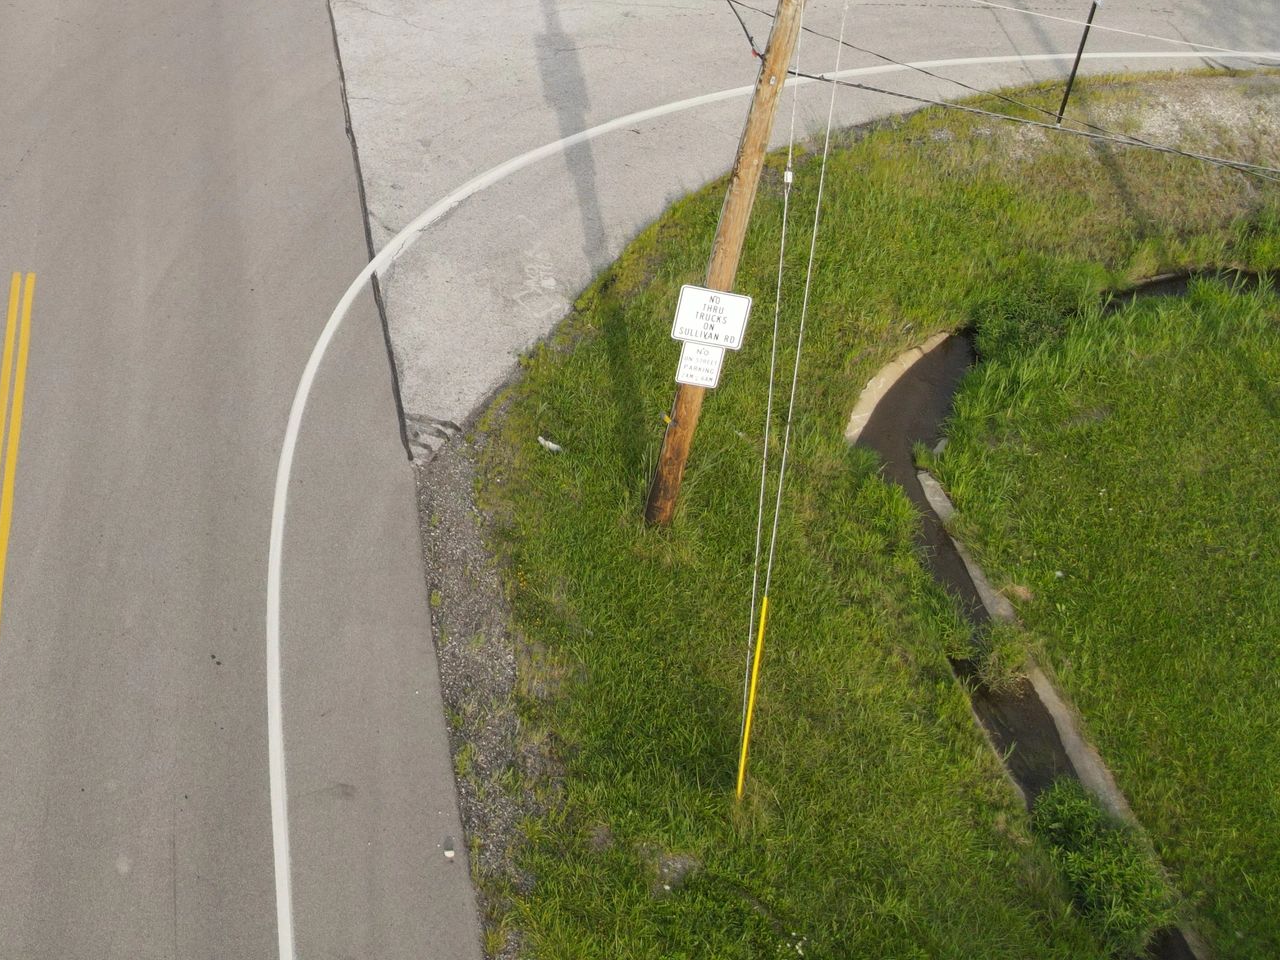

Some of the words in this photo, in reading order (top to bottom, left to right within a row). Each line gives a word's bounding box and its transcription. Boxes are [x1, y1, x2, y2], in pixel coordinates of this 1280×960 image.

[709, 295, 720, 304] NO
[703, 303, 724, 314] THRU
[695, 311, 727, 324] TRUCKS
[703, 322, 714, 330] ON
[679, 326, 720, 340] SULLIVAN
[724, 335, 735, 343] RD
[696, 348, 710, 356] NO
[683, 363, 715, 375] PARKING
